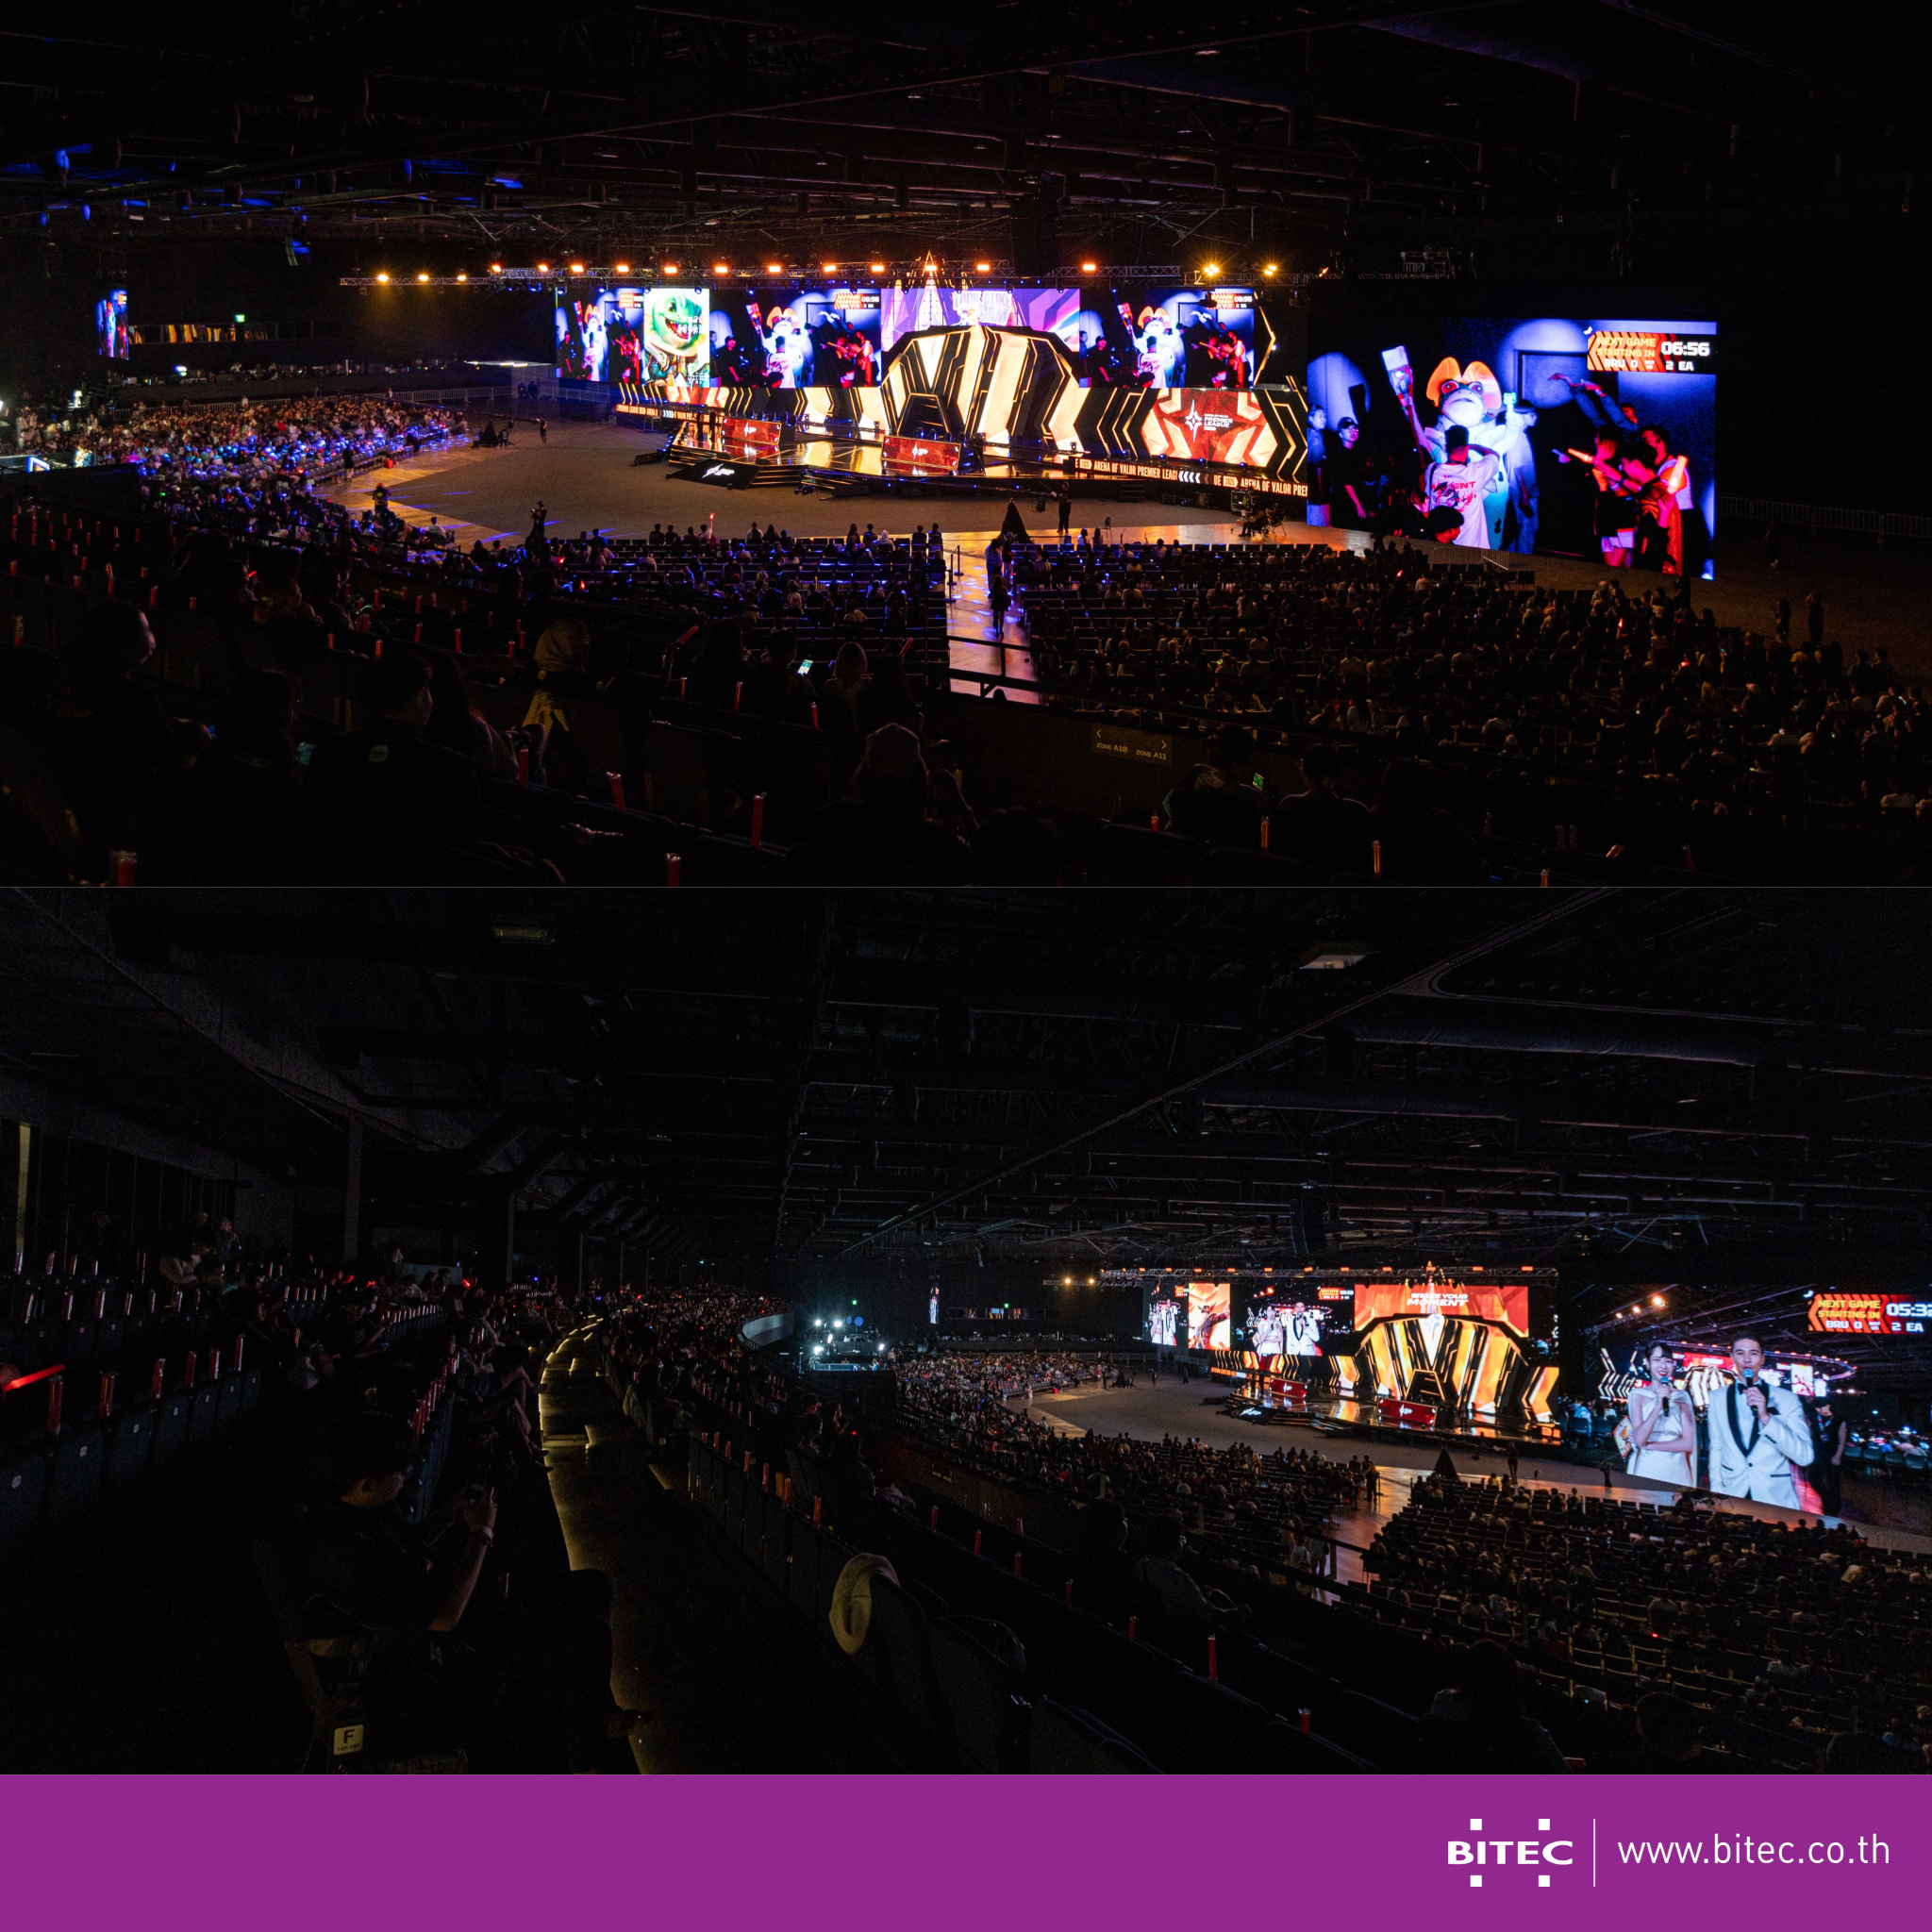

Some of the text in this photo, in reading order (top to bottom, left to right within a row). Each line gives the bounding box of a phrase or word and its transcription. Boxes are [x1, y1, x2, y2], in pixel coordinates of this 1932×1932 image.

[1596, 337, 1656, 347] NEXT GAME
[1596, 348, 1641, 358] STARTING
[1660, 341, 1710, 357] 06:56
[1604, 358, 1625, 368] BRU
[1665, 360, 1694, 372] 2 EA
[1093, 460, 1110, 472] ARENA
[1111, 462, 1119, 474] OF
[1120, 463, 1137, 475] VALOR
[1137, 465, 1160, 478] PREMIER
[1261, 480, 1270, 492] OF
[1272, 482, 1291, 494] VALOR
[1113, 744, 1128, 753] A10
[1136, 749, 1152, 758] ZONE
[1849, 1300, 1881, 1308] GAME
[1825, 1320, 1849, 1328] BRU
[1890, 1322, 1924, 1332] 2 EA
[343, 1729, 356, 1744] F
